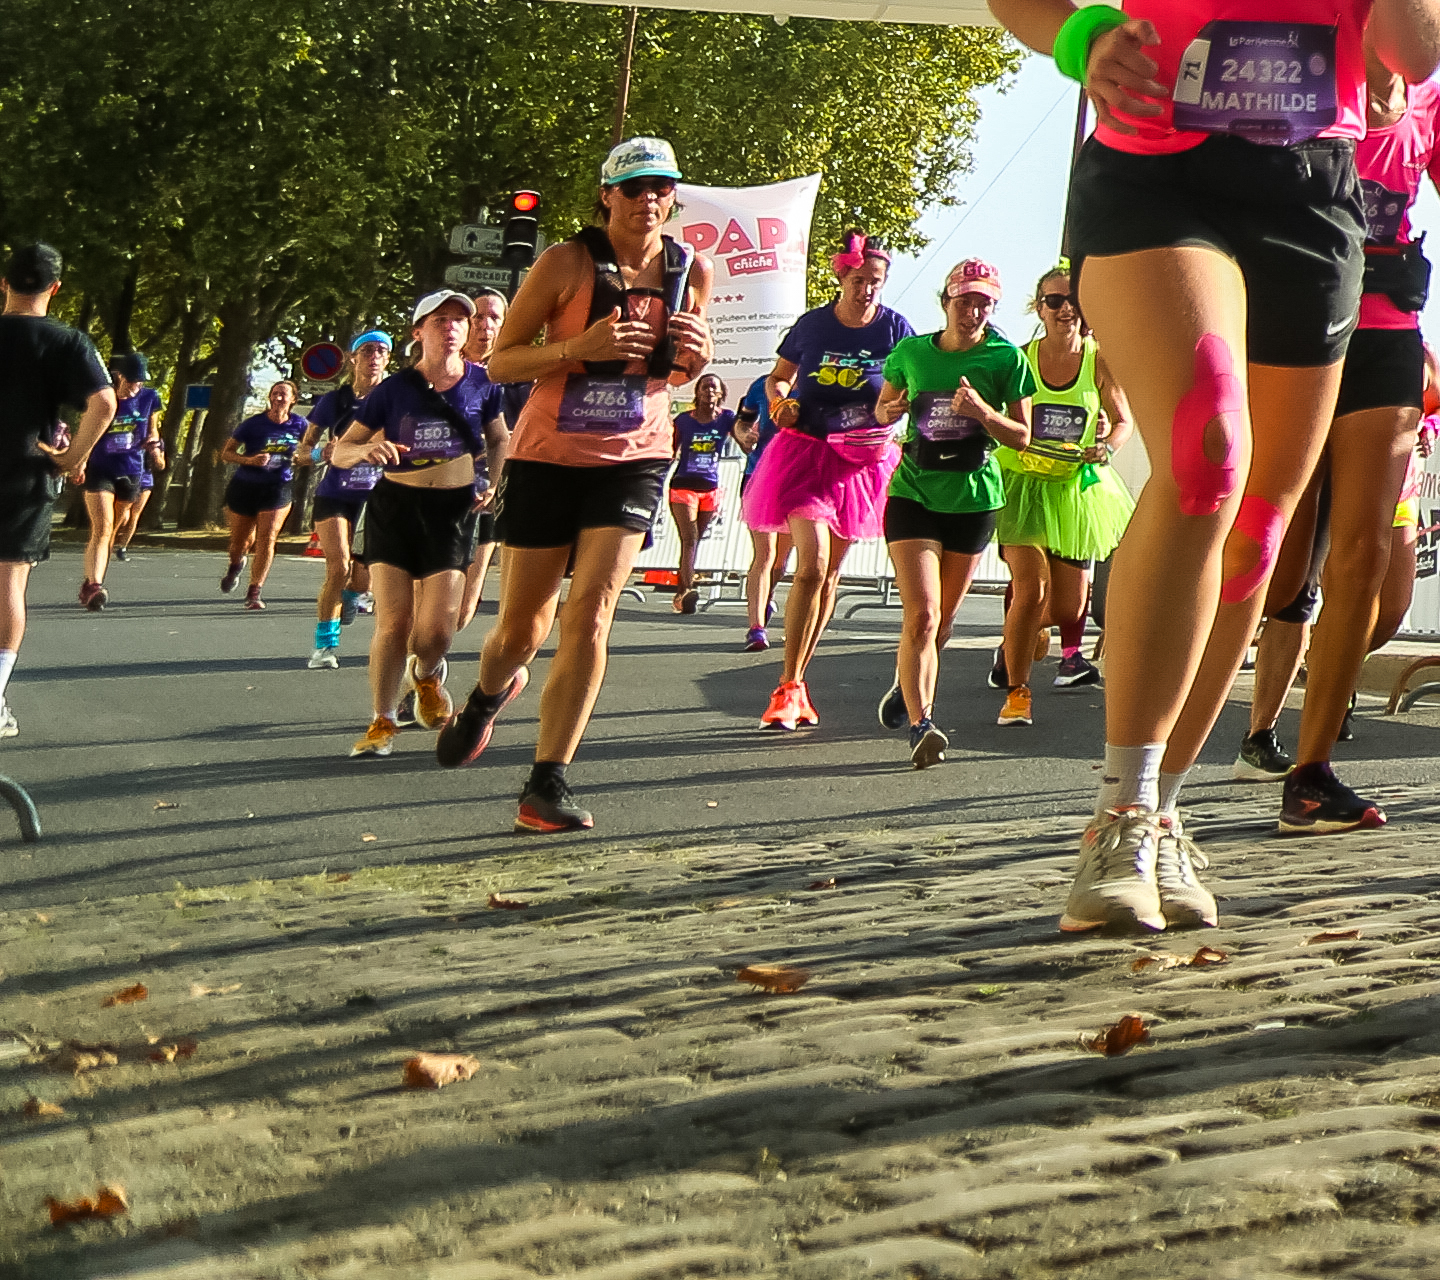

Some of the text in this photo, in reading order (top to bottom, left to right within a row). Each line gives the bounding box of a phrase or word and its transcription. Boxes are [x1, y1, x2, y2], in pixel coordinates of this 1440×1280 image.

[1220, 59, 1302, 83] 24322
[1201, 91, 1317, 113] MATHILDE
[733, 256, 773, 271] chiche
[583, 391, 628, 407] 4766
[572, 408, 636, 418] CHARLOTTE
[1042, 414, 1072, 428] 3709
[414, 426, 451, 441] 5503
